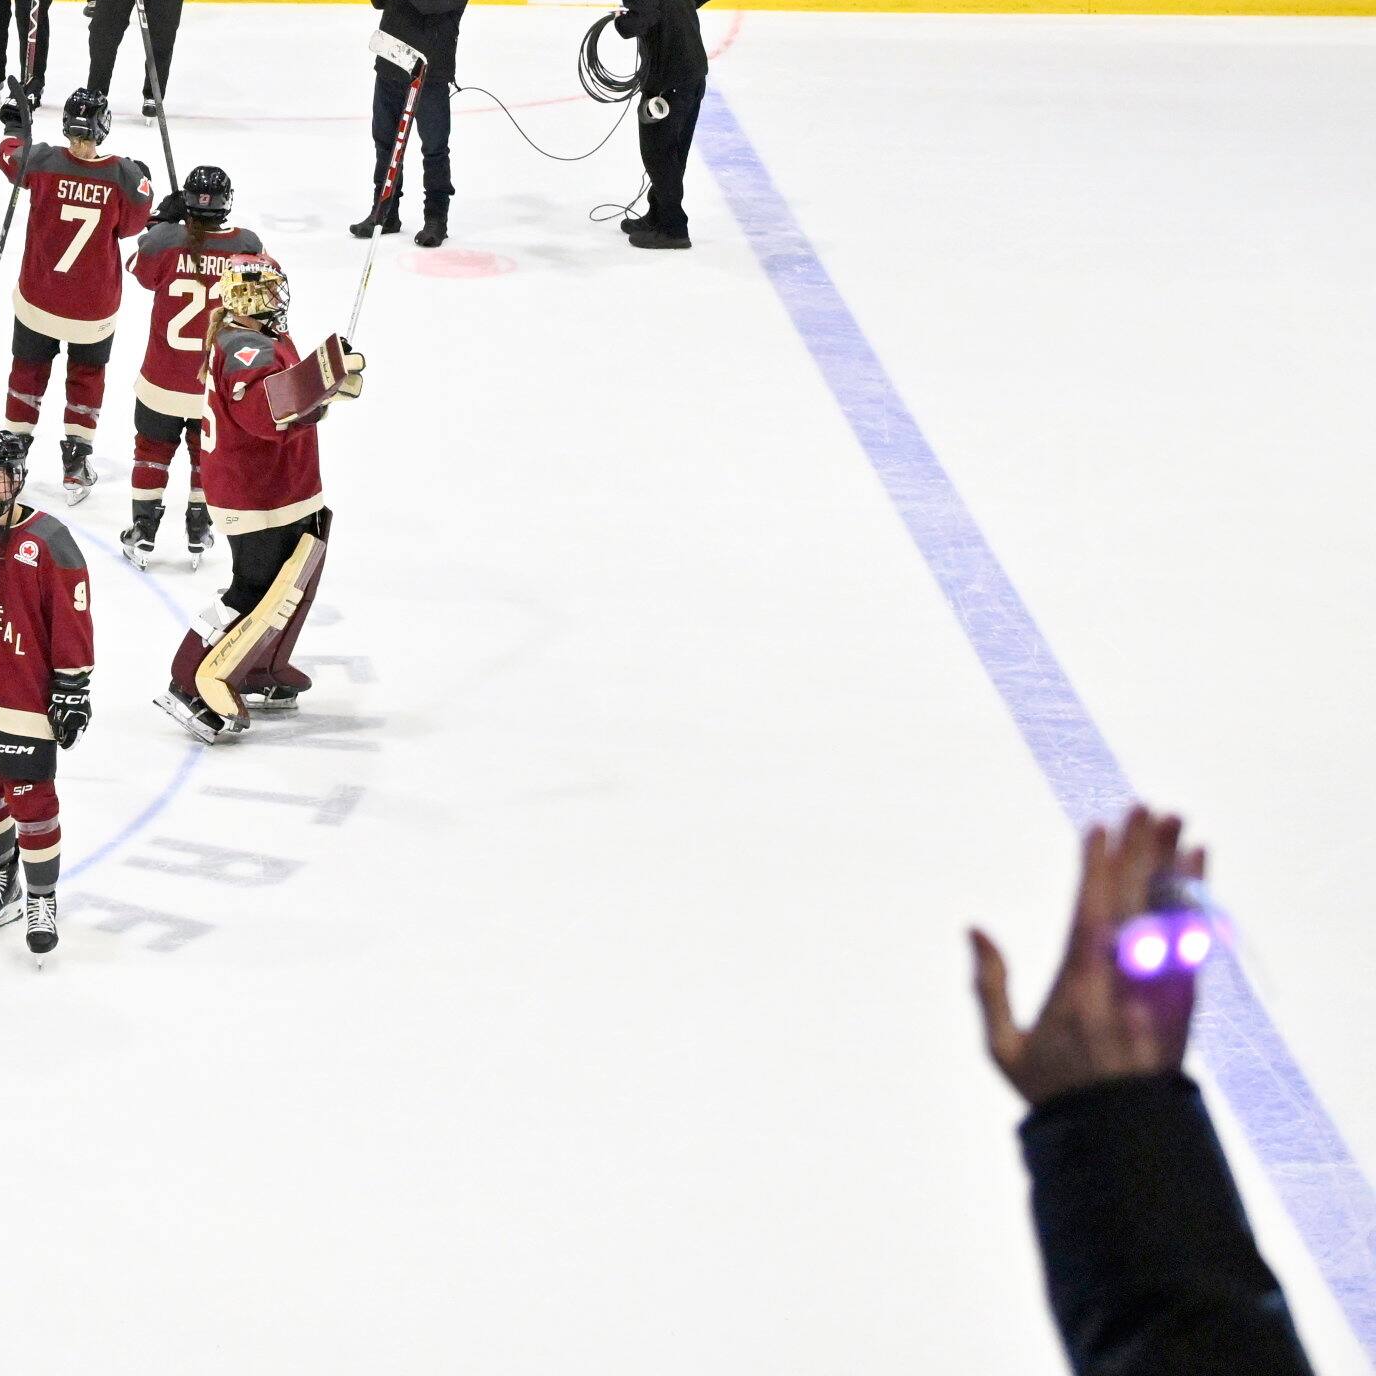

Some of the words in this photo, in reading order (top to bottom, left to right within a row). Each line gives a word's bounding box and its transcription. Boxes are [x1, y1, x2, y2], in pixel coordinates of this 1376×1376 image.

[57, 179, 113, 206] STACEY
[53, 204, 101, 273] 7
[208, 617, 254, 669] TRUE
[12, 783, 34, 798] SP
